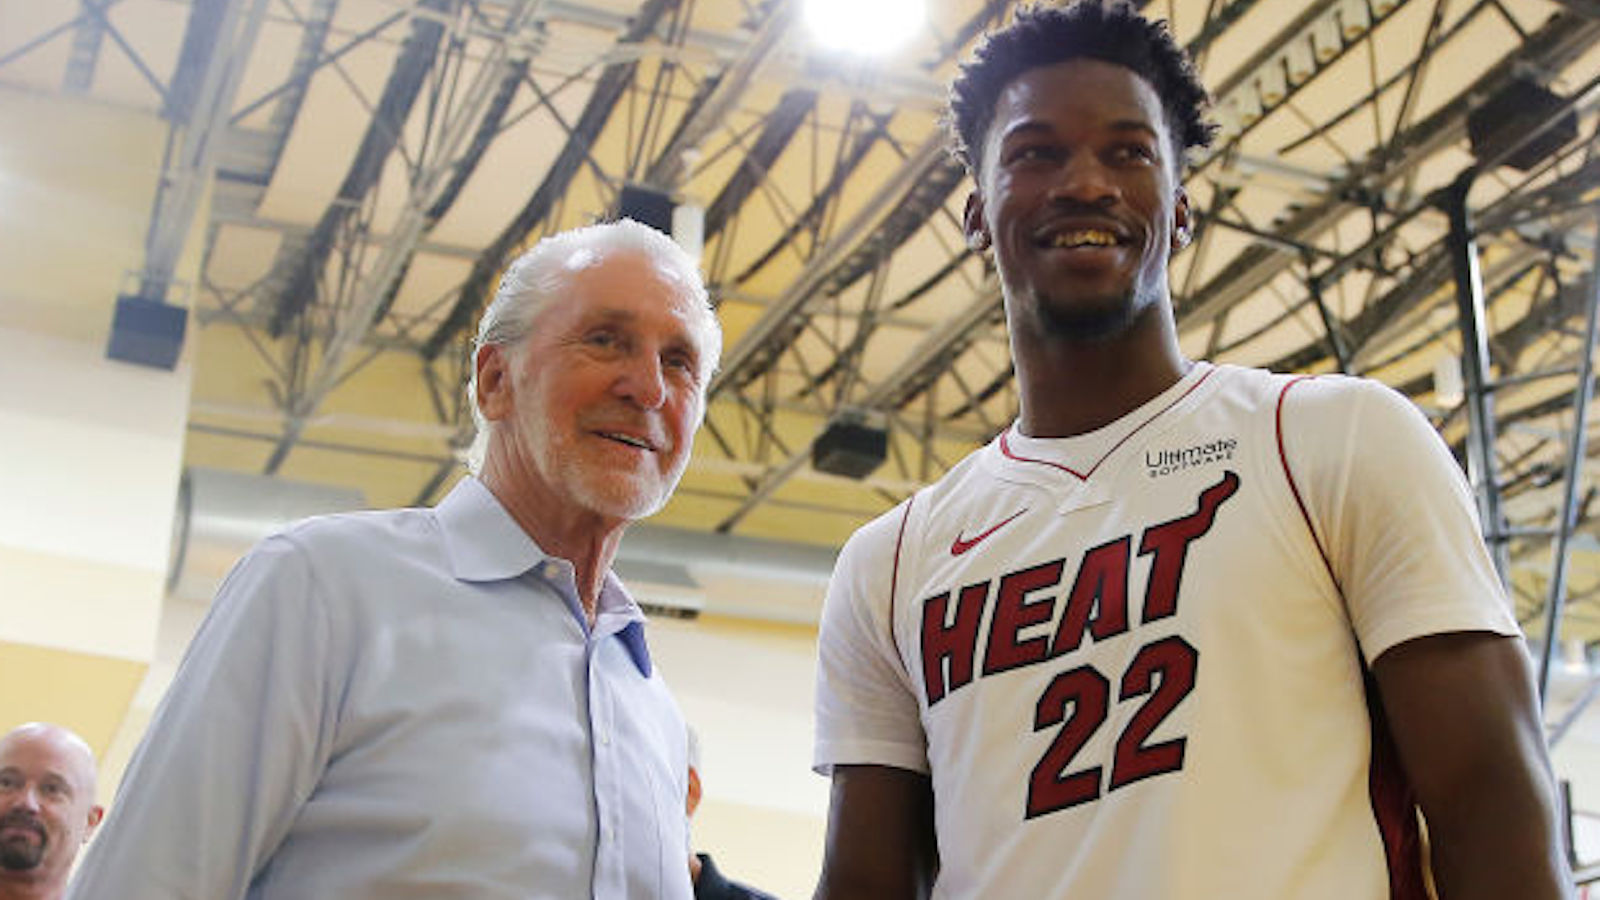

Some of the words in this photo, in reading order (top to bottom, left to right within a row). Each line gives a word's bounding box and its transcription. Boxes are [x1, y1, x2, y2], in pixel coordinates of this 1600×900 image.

[1146, 438, 1237, 468] Ultimate
[1149, 451, 1233, 478] SOFTWARE
[920, 470, 1241, 707] HEAT
[1024, 635, 1199, 820] 22
